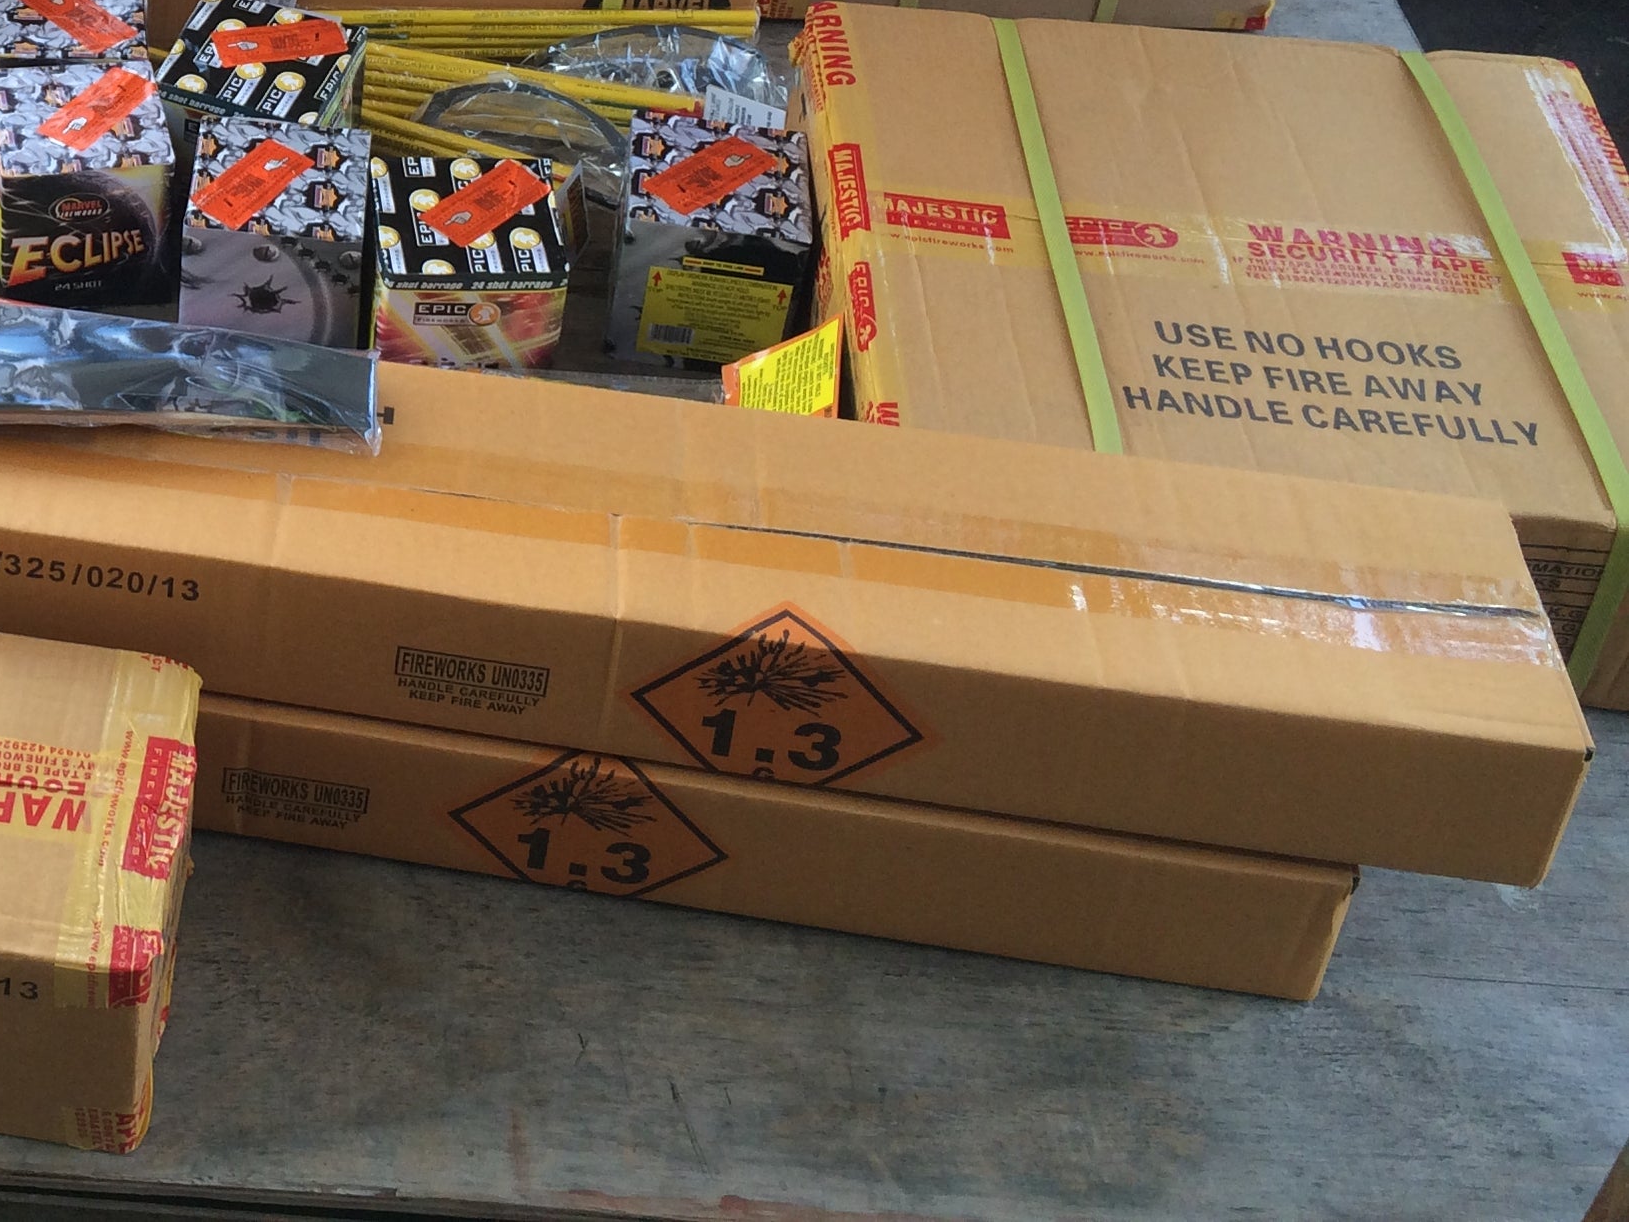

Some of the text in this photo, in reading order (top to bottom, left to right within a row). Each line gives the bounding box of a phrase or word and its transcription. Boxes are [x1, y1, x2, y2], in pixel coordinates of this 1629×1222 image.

[880, 196, 1000, 226] MAJESTIC
[8, 229, 146, 286] ECLIPSE
[1247, 224, 1459, 259] WARNING
[1247, 241, 1400, 267] SECURITY
[1408, 255, 1491, 276] TAPE
[418, 304, 467, 315] EPIC
[1154, 320, 1463, 371] USE NO HOOKS
[1152, 353, 1483, 407] KEEP FIRE AWAY
[1122, 386, 1539, 448] HANDLE CAREFULLY
[401, 652, 486, 684] FIREWORKS
[398, 677, 540, 707] HANDLE CAREFULLY
[409, 690, 526, 715] KEEP FIRE AWAY
[701, 708, 843, 772] 1.3
[229, 773, 309, 800] FIREWORKS
[517, 828, 652, 885] 1.3
